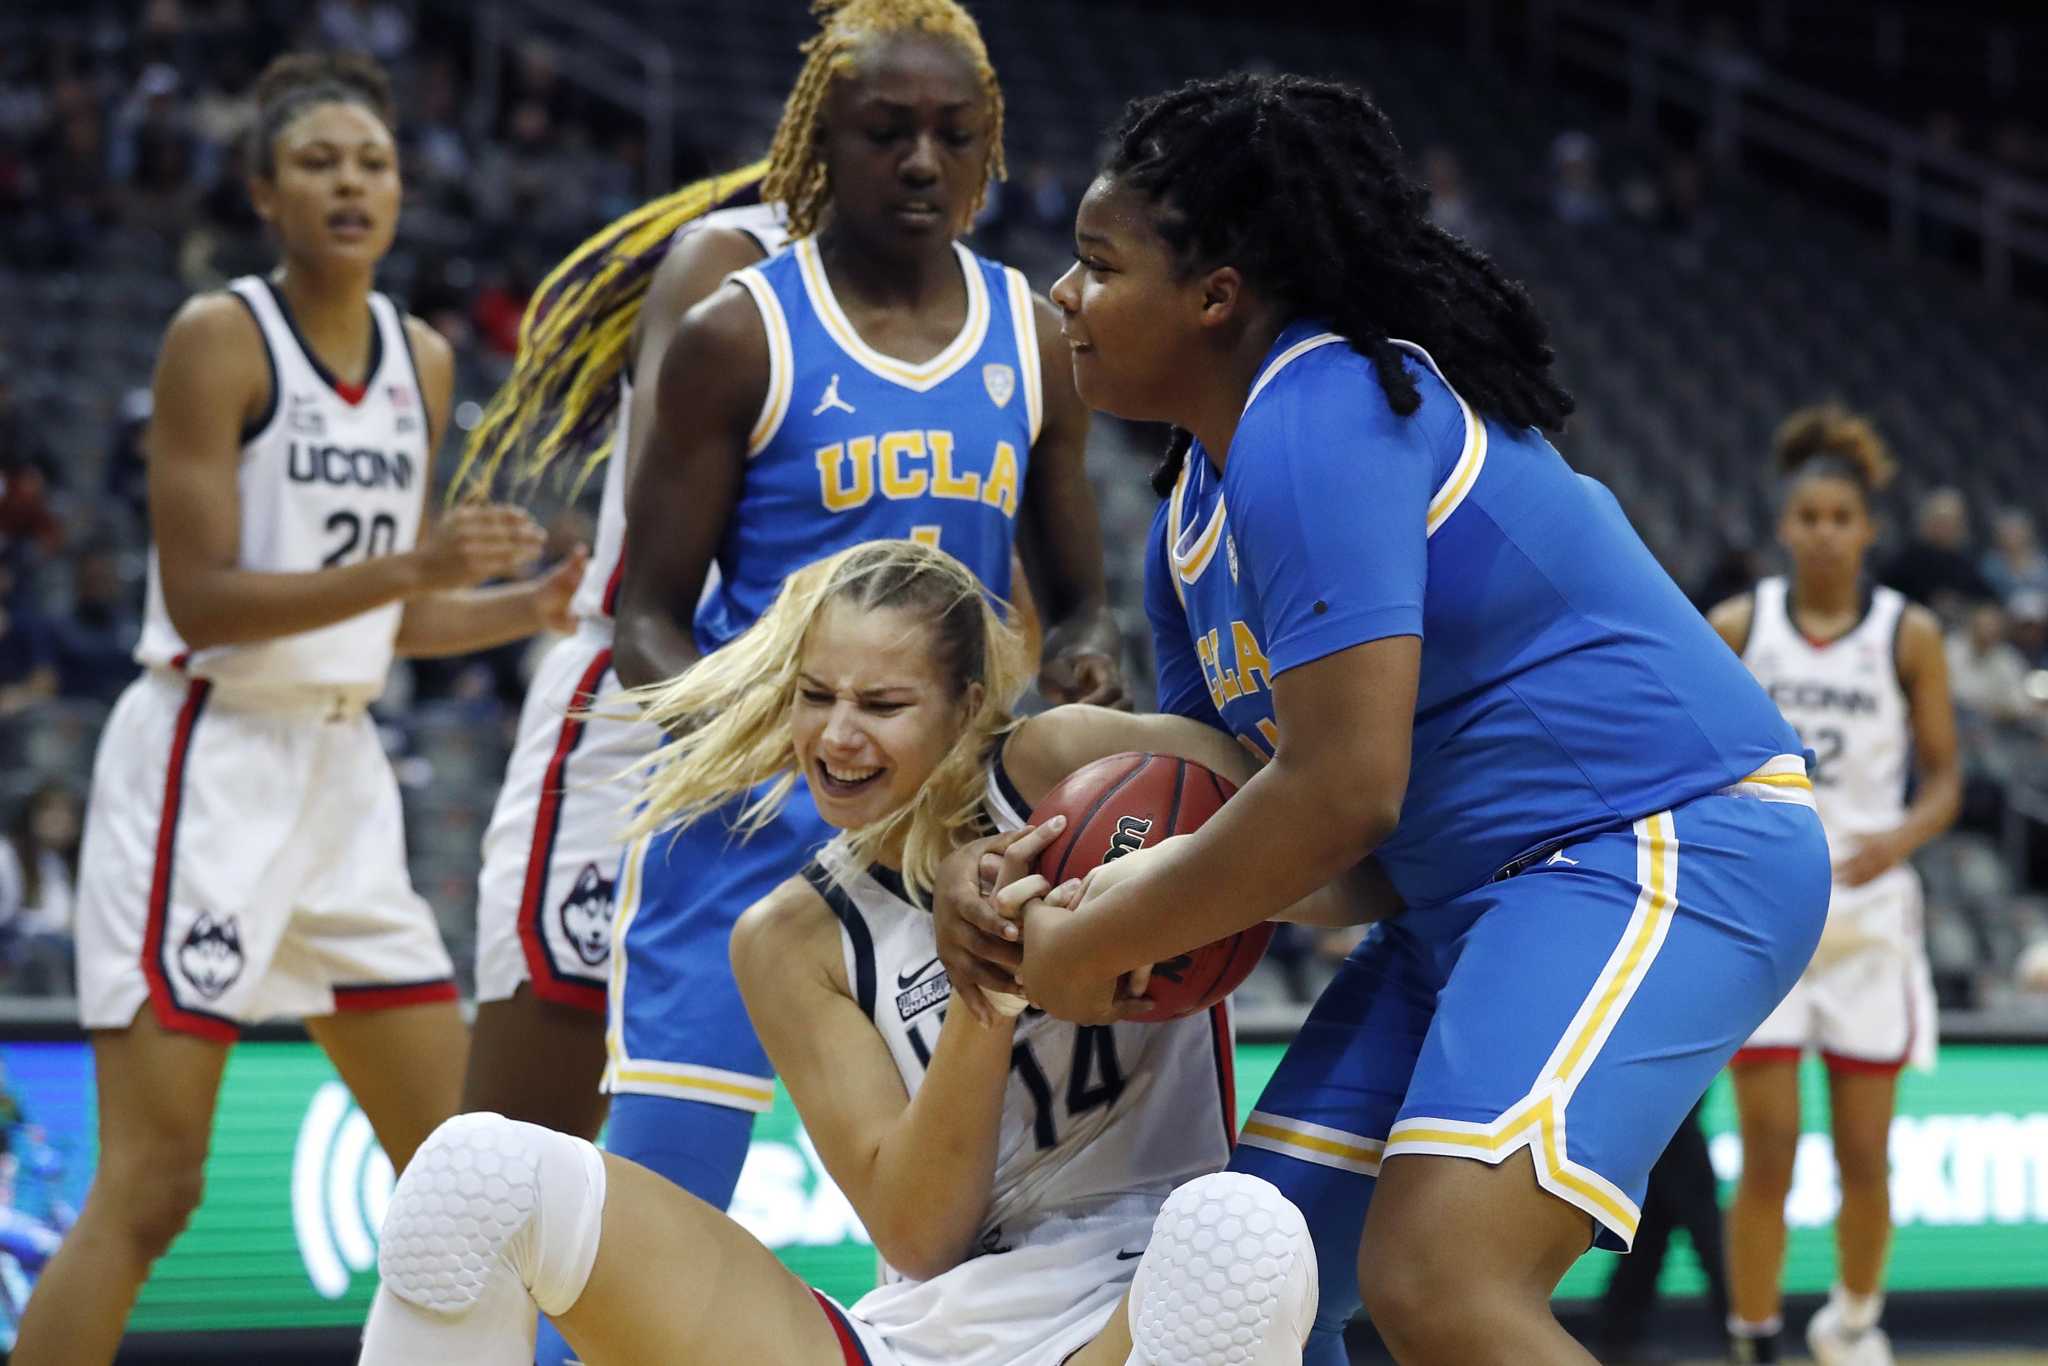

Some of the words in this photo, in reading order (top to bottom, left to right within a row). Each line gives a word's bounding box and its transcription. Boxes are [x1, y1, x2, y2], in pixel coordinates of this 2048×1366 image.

[289, 442, 412, 488] UCONN
[816, 429, 1018, 519] UCLA
[322, 510, 397, 571] 20
[1197, 620, 1272, 712] CLA
[1767, 682, 1876, 713] CONN
[1010, 1023, 1130, 1151] 14
